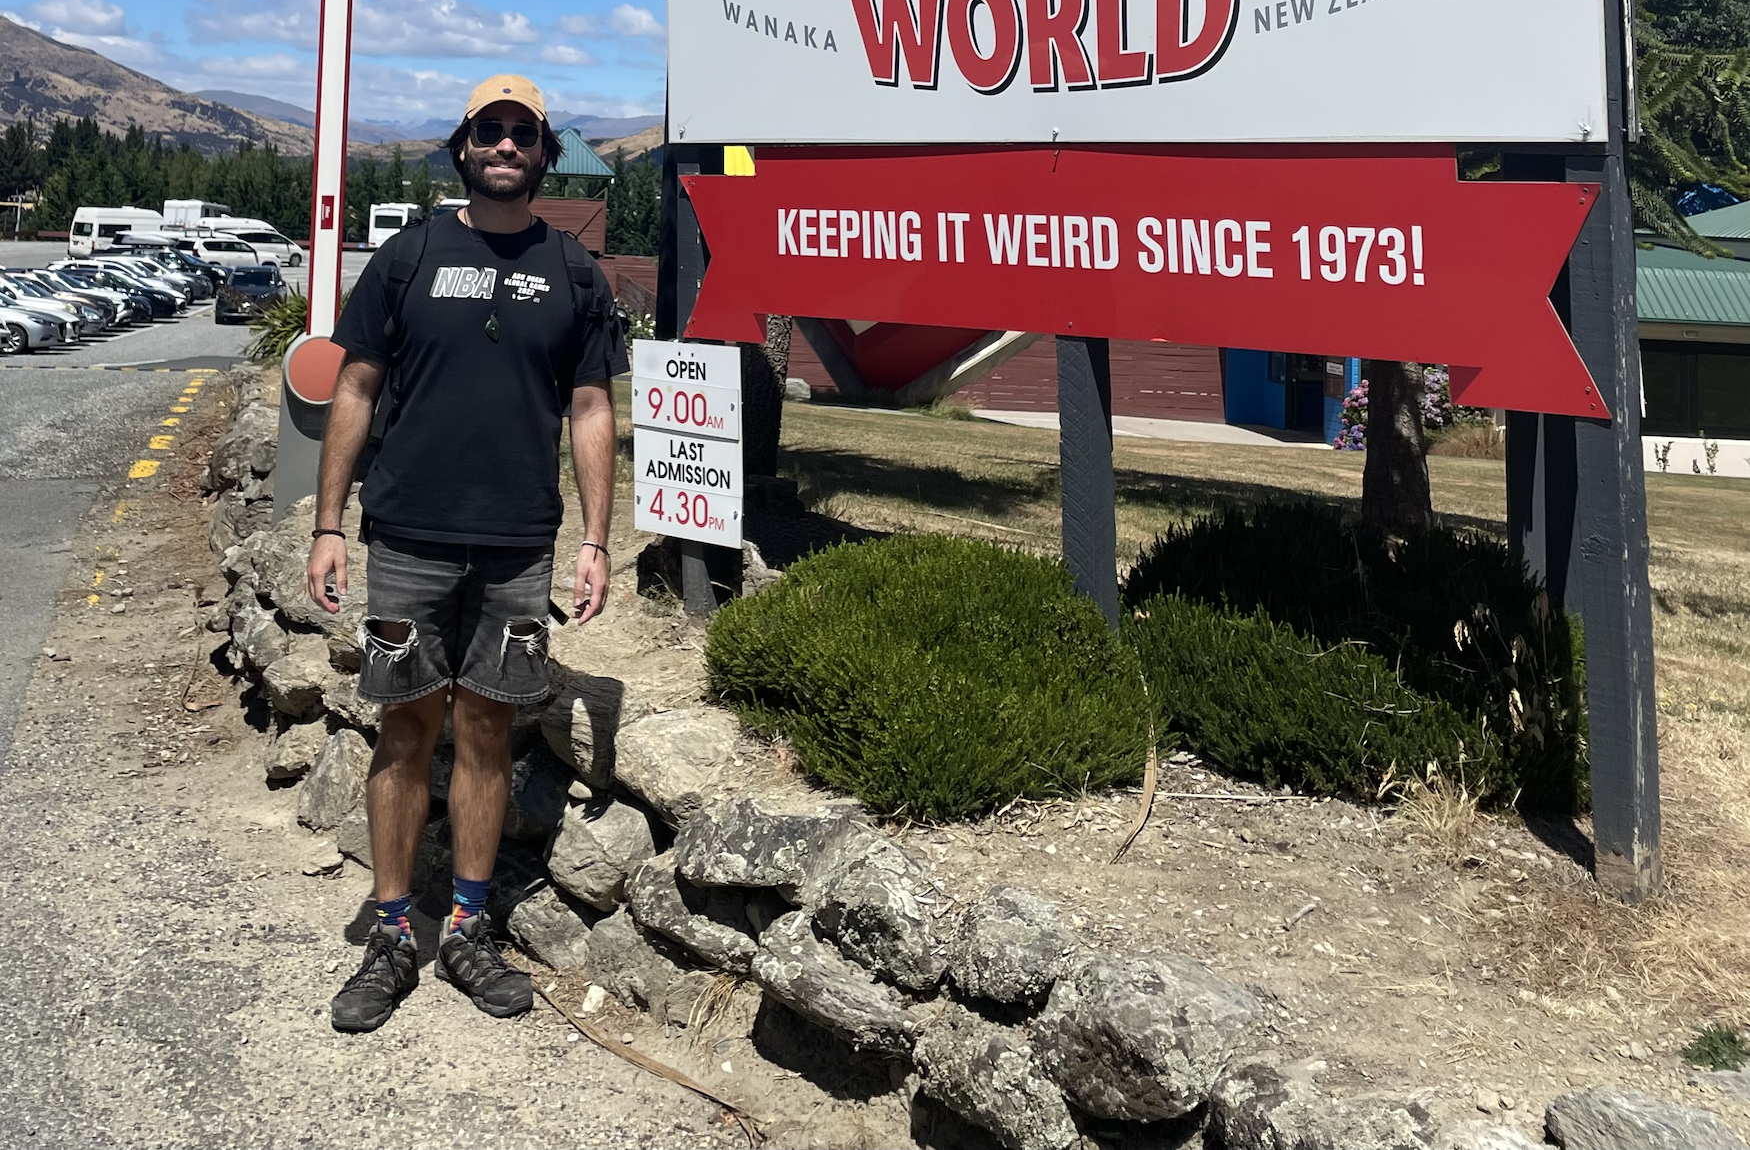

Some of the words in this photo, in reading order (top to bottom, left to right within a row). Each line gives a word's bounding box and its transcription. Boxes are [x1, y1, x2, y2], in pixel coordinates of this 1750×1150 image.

[777, 207, 922, 262] KEEPING
[937, 212, 971, 264] IT
[984, 213, 1119, 271] WEIRD
[1137, 218, 1273, 280] SINCE
[1291, 225, 1426, 286] 1973!
[430, 266, 498, 300] NBA
[666, 359, 707, 381] OPEN
[669, 439, 705, 462] LAST
[645, 459, 731, 490] ADMISSION
